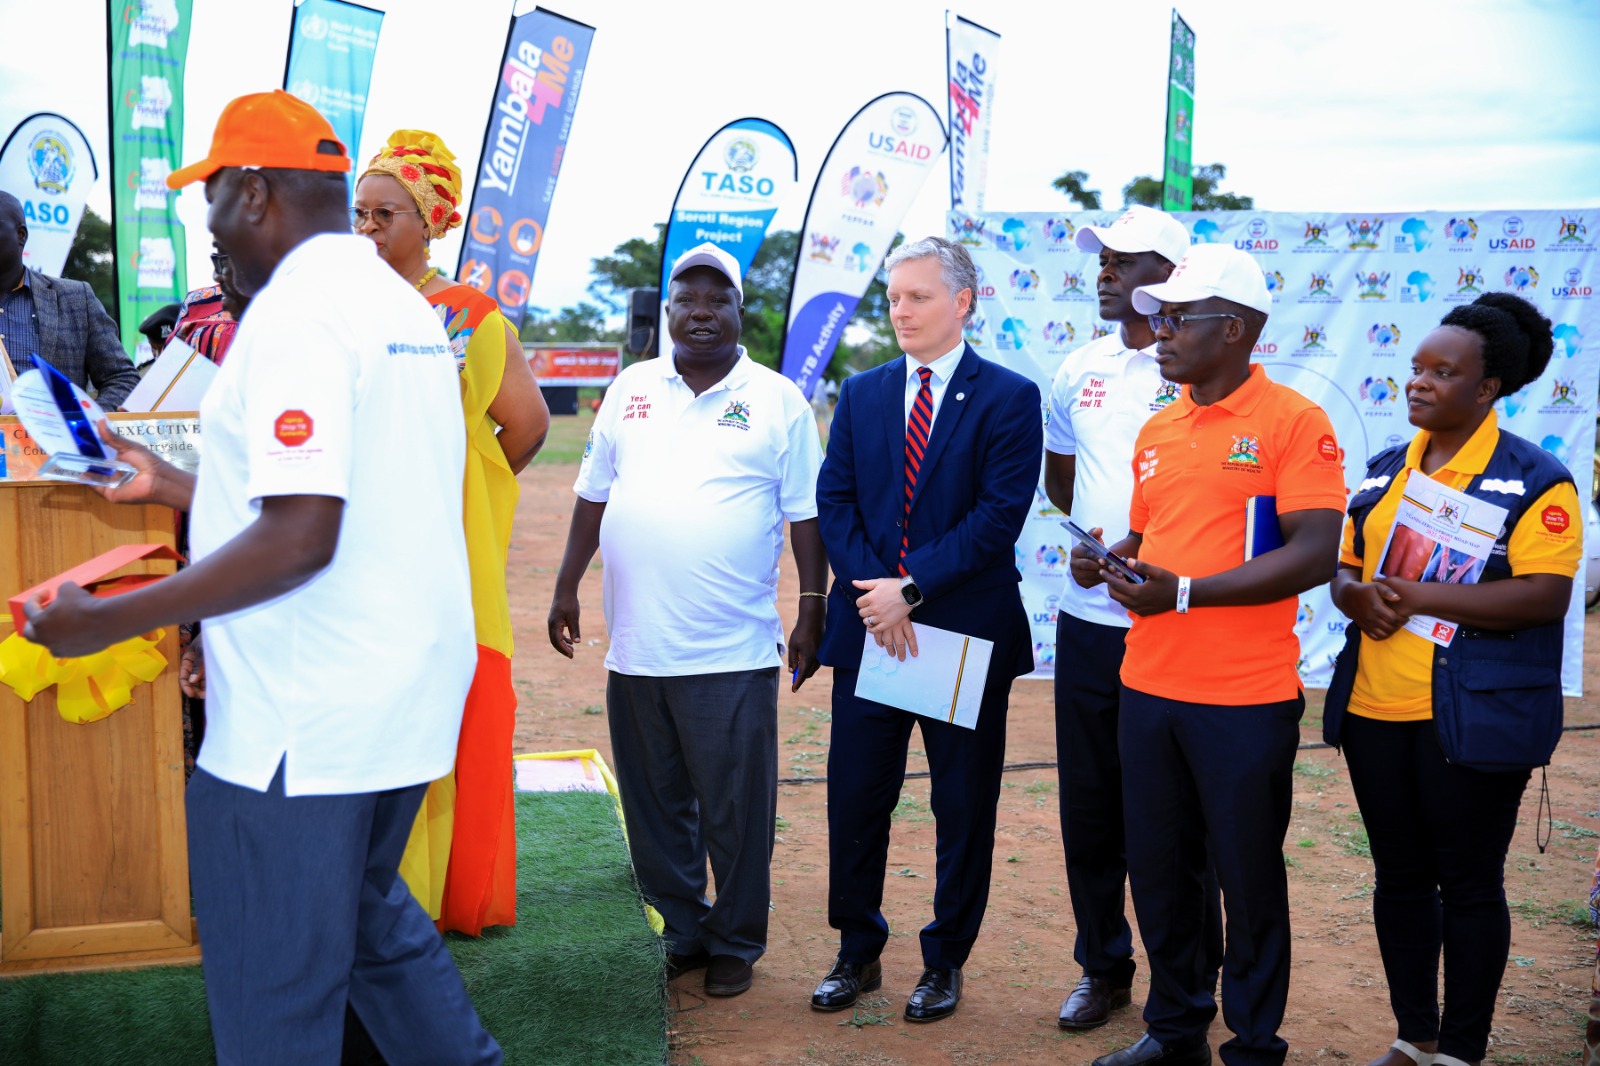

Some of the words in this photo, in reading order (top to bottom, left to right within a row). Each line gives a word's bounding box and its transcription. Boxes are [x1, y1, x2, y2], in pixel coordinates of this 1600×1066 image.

[480, 40, 543, 193] Yambala
[868, 131, 931, 160] USAID
[701, 171, 775, 196] TASO
[23, 200, 70, 226] ASO
[718, 213, 764, 228] Region
[695, 228, 743, 243] Project
[1234, 239, 1279, 250] USAID
[1488, 238, 1536, 249] USAID
[1552, 286, 1593, 297] USAID
[812, 301, 847, 358] Activity
[1252, 343, 1278, 354] AID
[1090, 378, 1105, 387] Yes!
[1082, 388, 1093, 397] We
[1080, 399, 1092, 408] end
[116, 424, 201, 436] EXECUTIVE
[1033, 613, 1058, 623] USA
